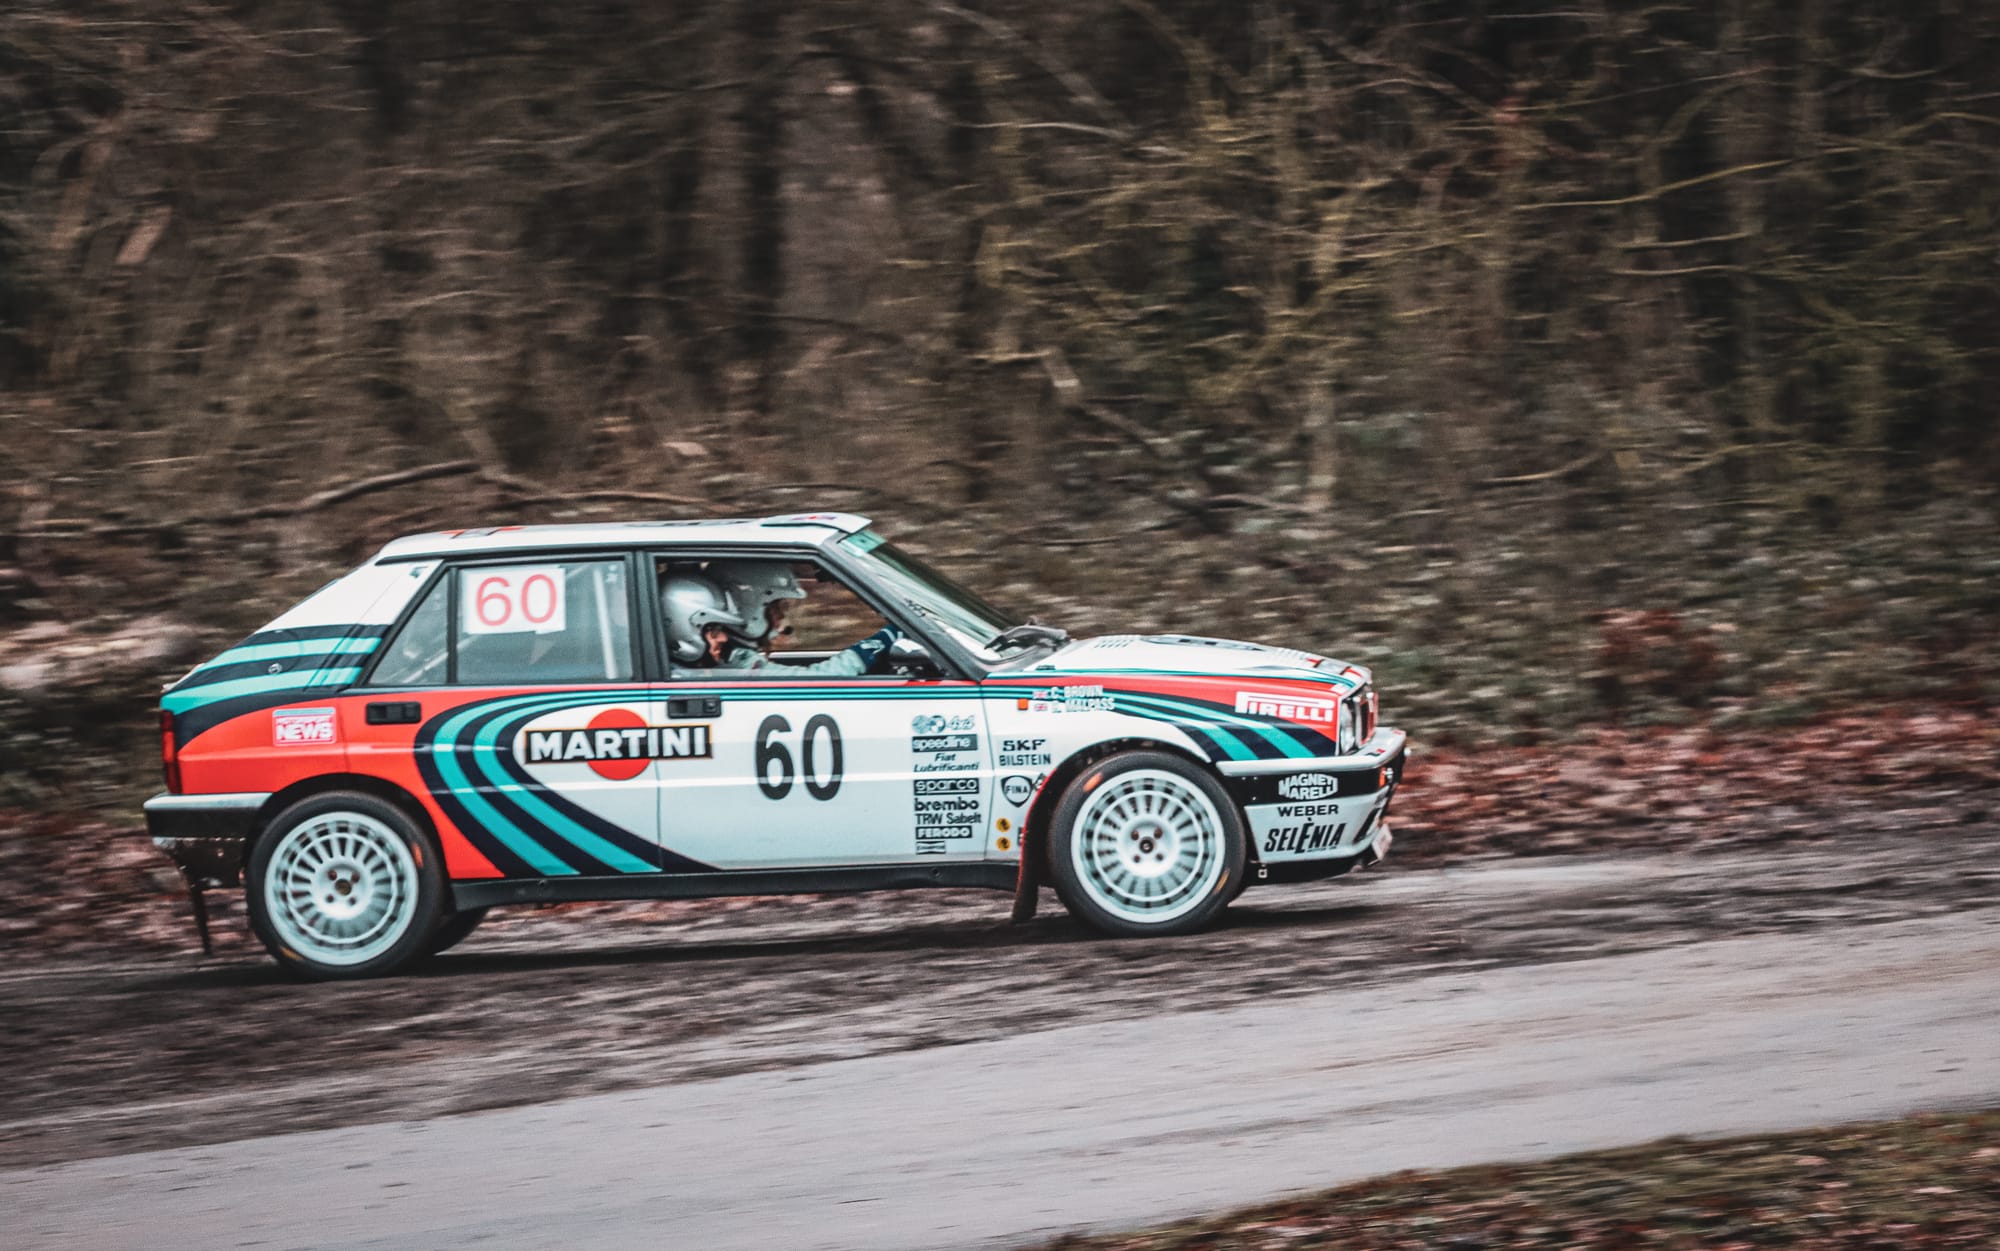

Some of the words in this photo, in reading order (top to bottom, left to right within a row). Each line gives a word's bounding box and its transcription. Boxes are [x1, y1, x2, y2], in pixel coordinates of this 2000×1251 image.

[476, 574, 557, 626] 60
[1234, 691, 1335, 722] PIRELLI
[275, 722, 333, 740] NEWS
[530, 727, 707, 761] MARTINI
[912, 736, 971, 751] speedline
[1002, 739, 1046, 752] SKF
[755, 713, 844, 802] 60
[935, 752, 956, 762] Fiat
[999, 753, 1051, 766] BILSTEIN
[916, 780, 977, 793] sparco
[1006, 785, 1029, 794] FINA
[914, 796, 979, 811] brembo
[1277, 804, 1339, 817] WEBER
[915, 813, 943, 824] TRW
[946, 812, 982, 824] Sabelt
[917, 826, 971, 838] FERODO
